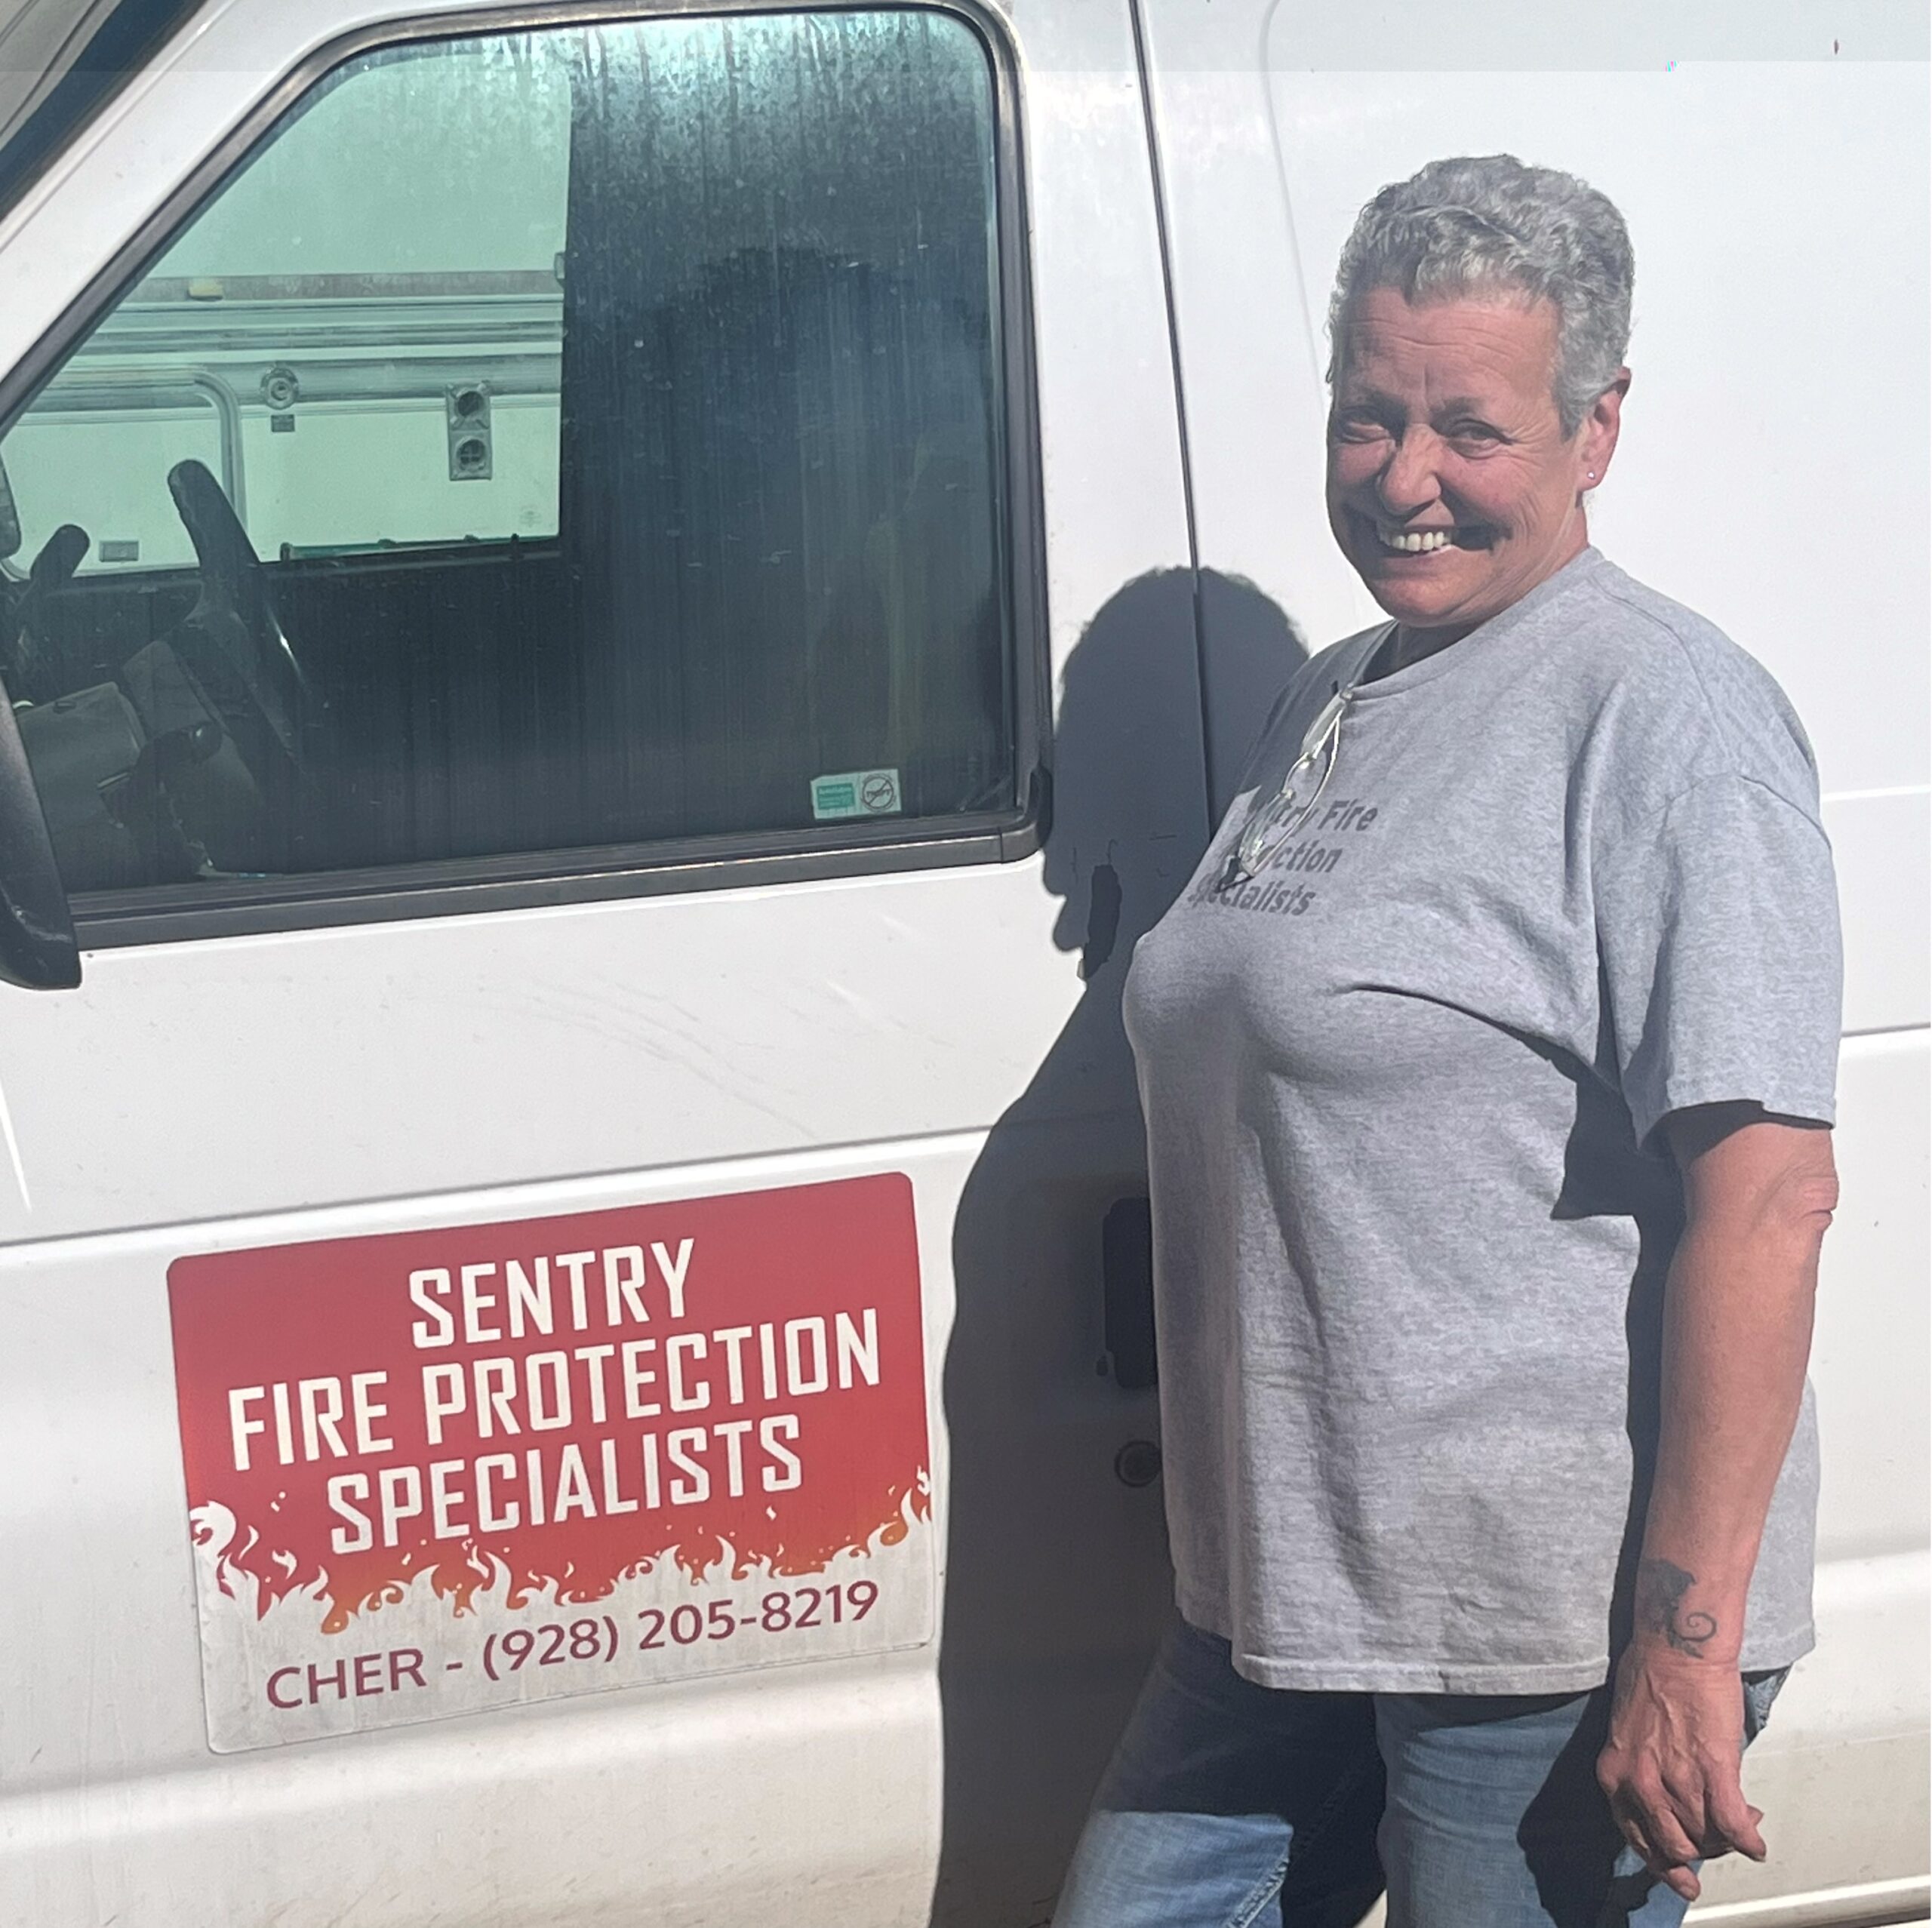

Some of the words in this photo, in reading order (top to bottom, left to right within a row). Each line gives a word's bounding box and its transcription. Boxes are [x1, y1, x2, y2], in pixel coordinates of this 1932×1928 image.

[1318, 798, 1378, 831] Fire
[410, 1239, 694, 1348] SENTRY
[229, 1372, 393, 1471] FIRE
[423, 1308, 878, 1444] PROTECTION
[328, 1415, 801, 1554] SPECIALISTS
[267, 1649, 426, 1708] CHER
[484, 1616, 619, 1680] (928)
[638, 1581, 878, 1650] 205-8219
